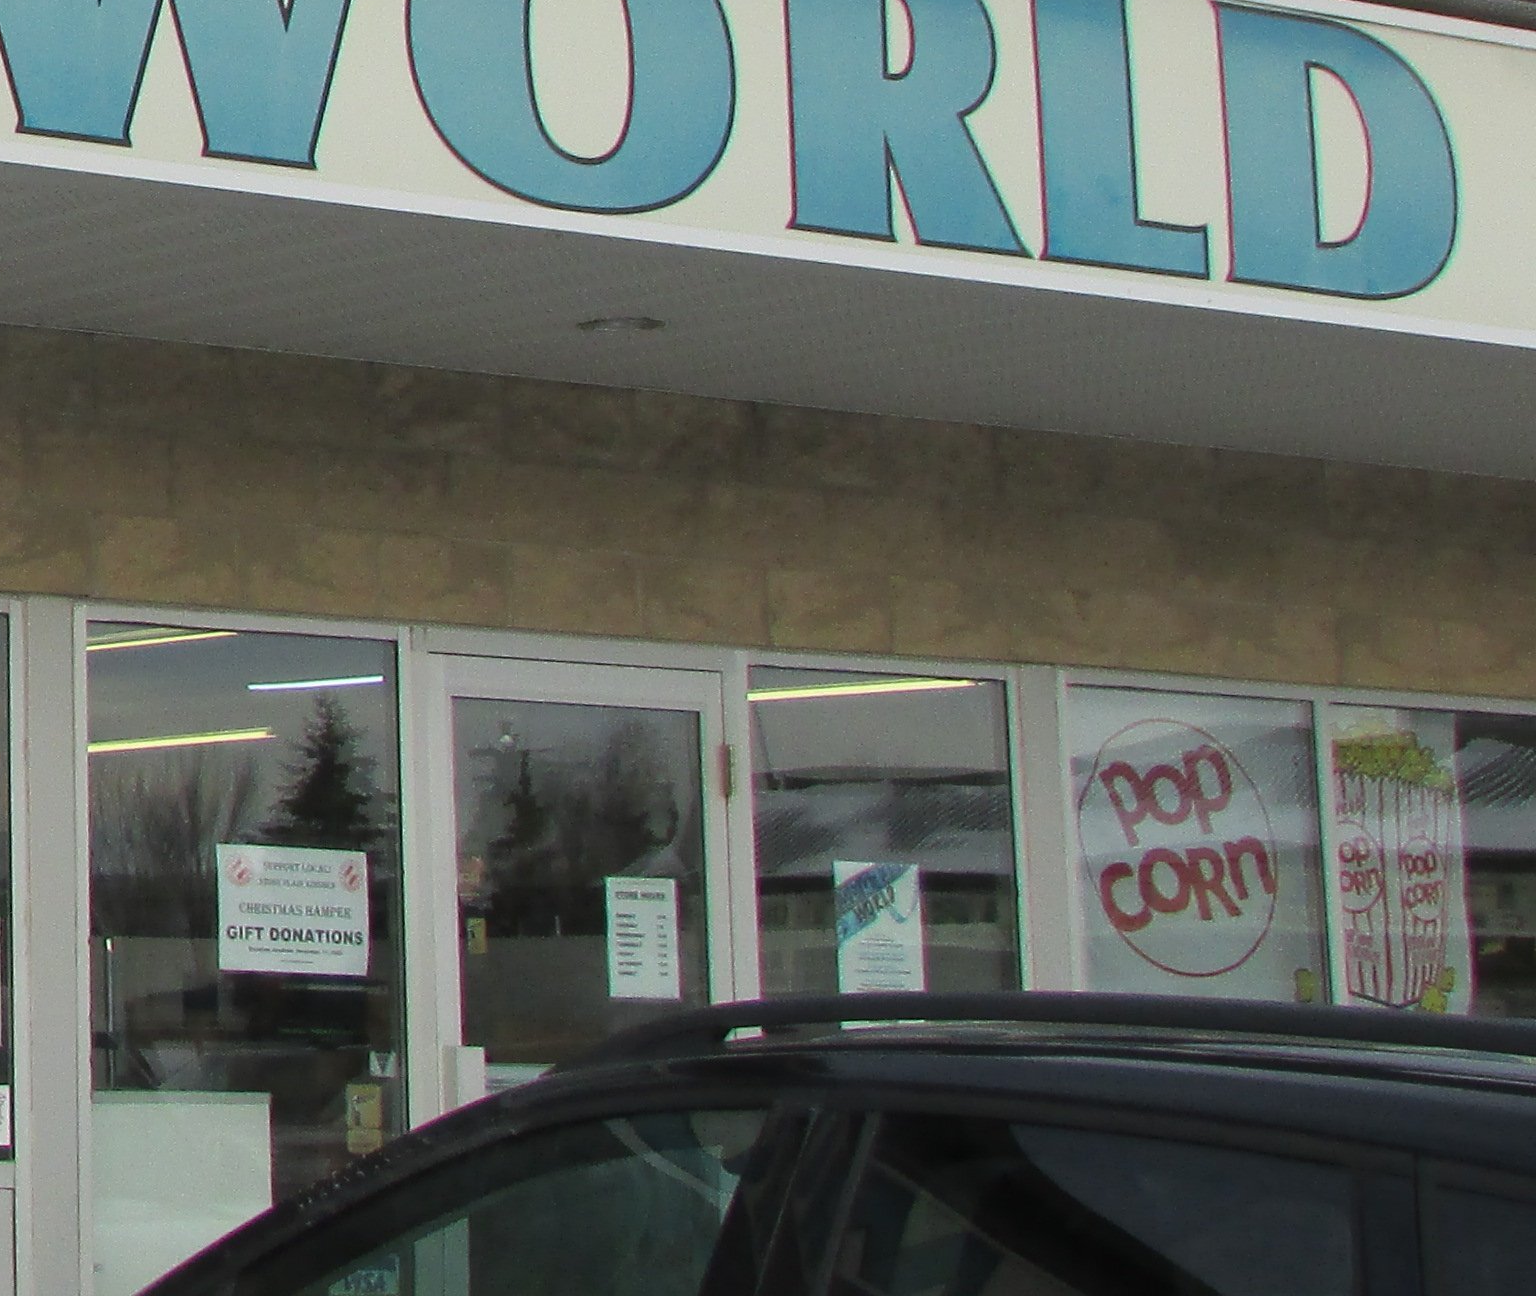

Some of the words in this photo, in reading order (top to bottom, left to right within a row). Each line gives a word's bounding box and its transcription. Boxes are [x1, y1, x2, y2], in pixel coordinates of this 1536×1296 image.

[238, 902, 303, 916] CHRISTMAS
[305, 905, 352, 920] HAMPER
[227, 925, 264, 940] GIFT
[269, 927, 364, 946] DONATIONS
